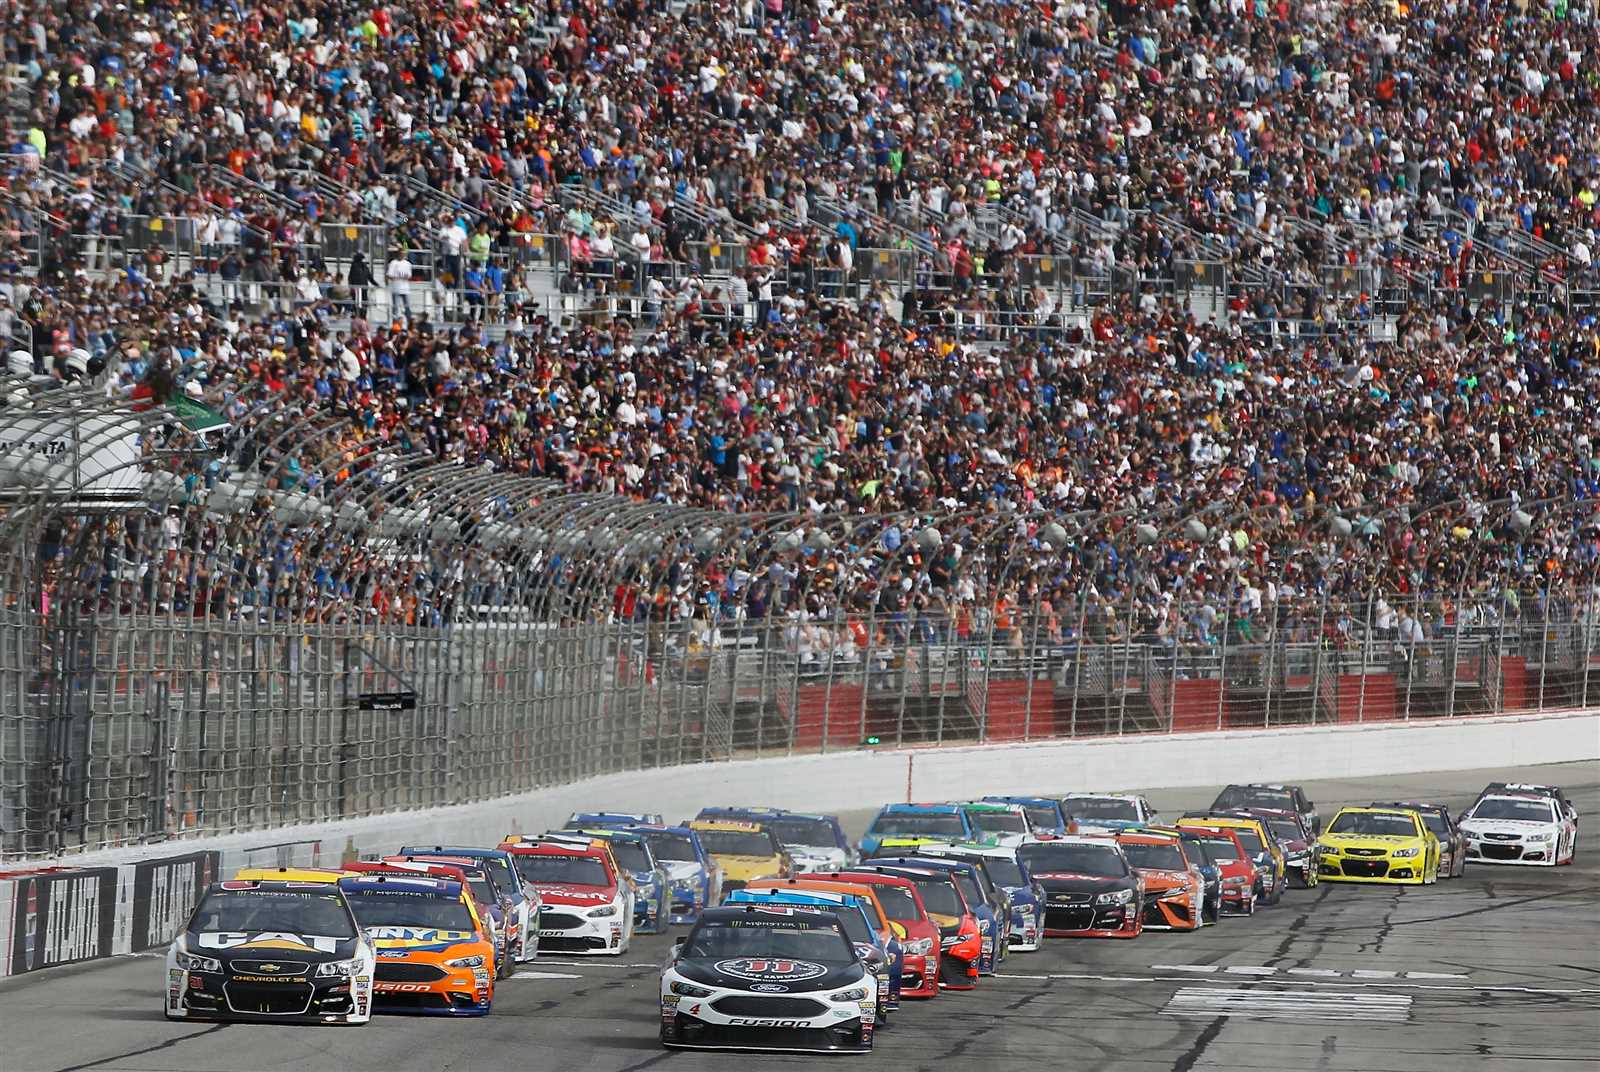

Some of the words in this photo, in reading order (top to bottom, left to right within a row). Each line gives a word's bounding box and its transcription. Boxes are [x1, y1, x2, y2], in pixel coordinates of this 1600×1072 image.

[43, 876, 100, 964] ATLANTA
[199, 931, 350, 954] CAT
[233, 975, 290, 983] CHEVROLET
[373, 983, 432, 992] USION
[690, 1003, 700, 1014] 4
[728, 1018, 812, 1028] FUSION
